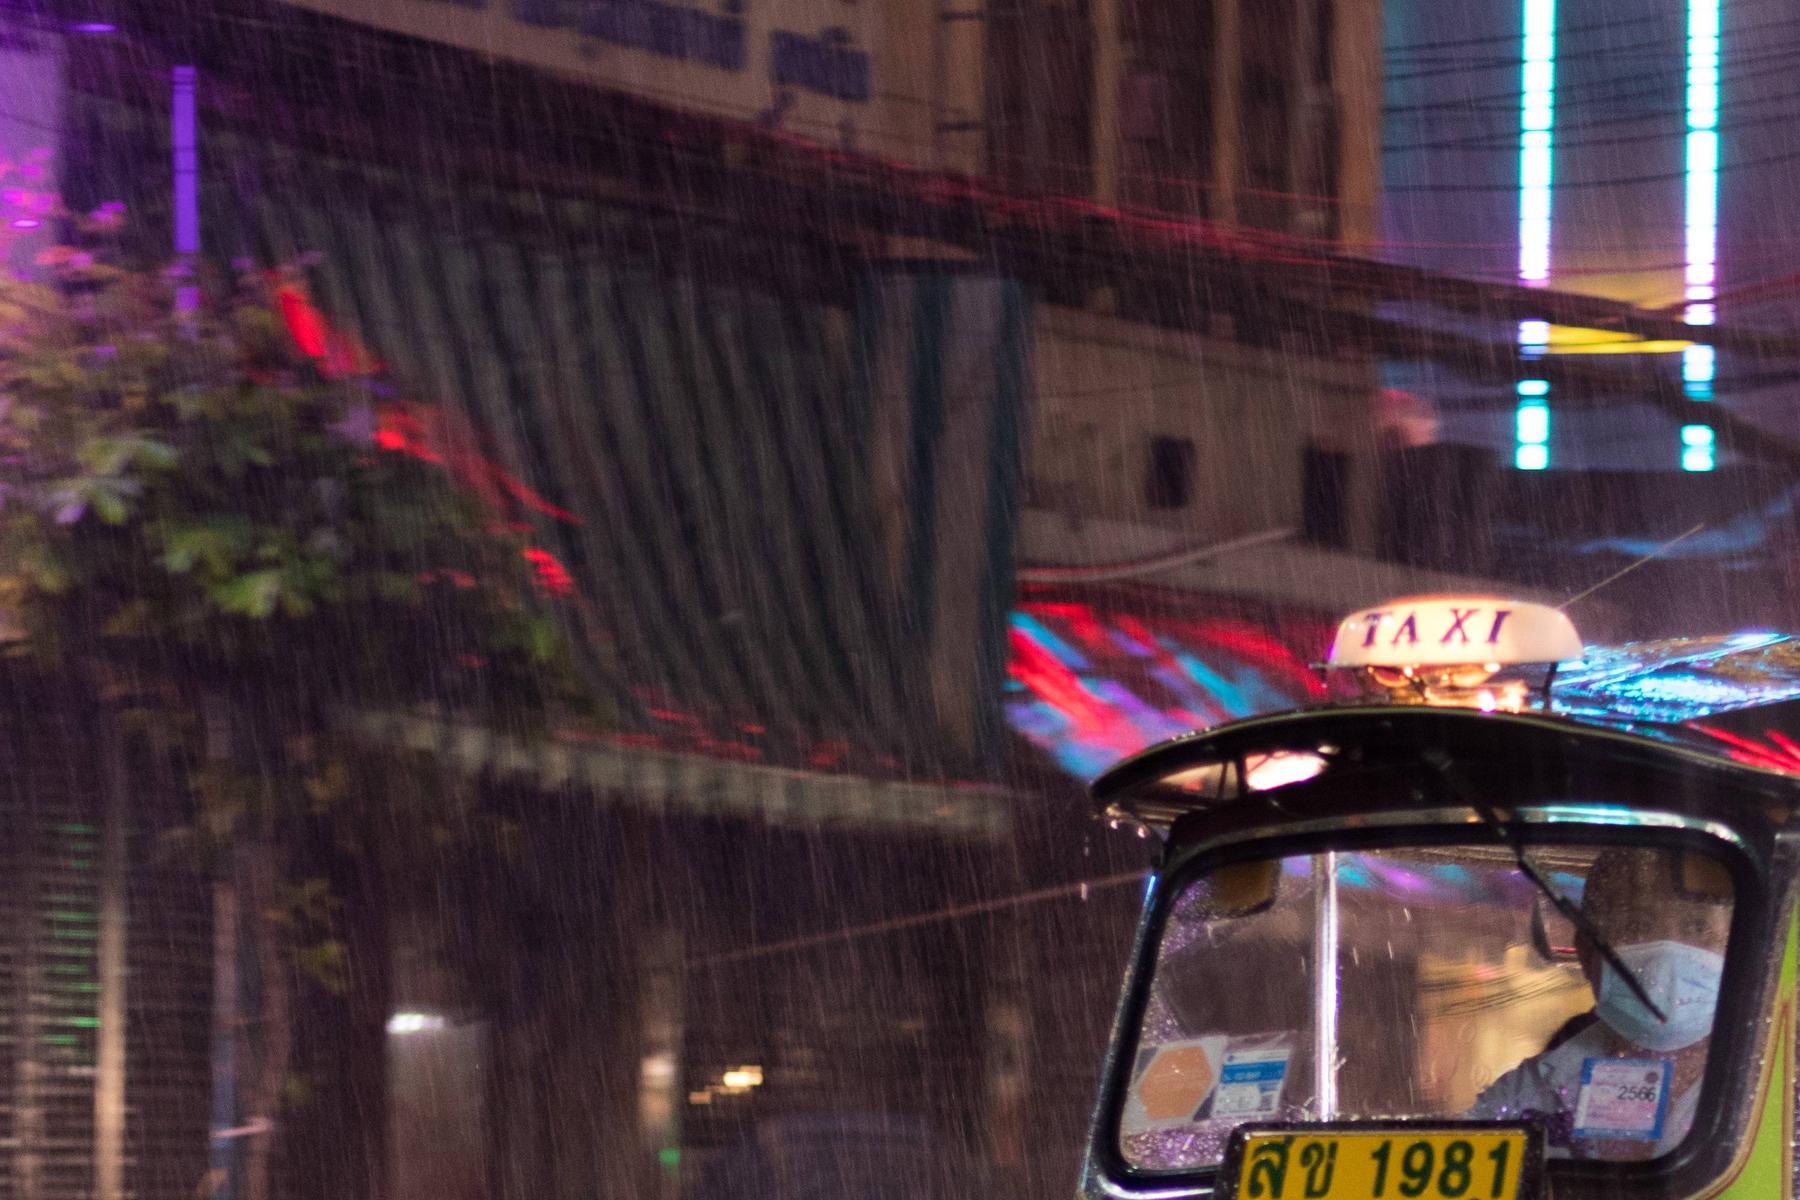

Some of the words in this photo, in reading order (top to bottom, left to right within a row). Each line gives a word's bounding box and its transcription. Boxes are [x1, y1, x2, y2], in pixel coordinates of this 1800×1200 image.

[1361, 608, 1511, 648] TAXI
[1616, 1084, 1657, 1103] 2566
[1247, 1135, 1338, 1200] สข
[1371, 1138, 1511, 1200] 1981
